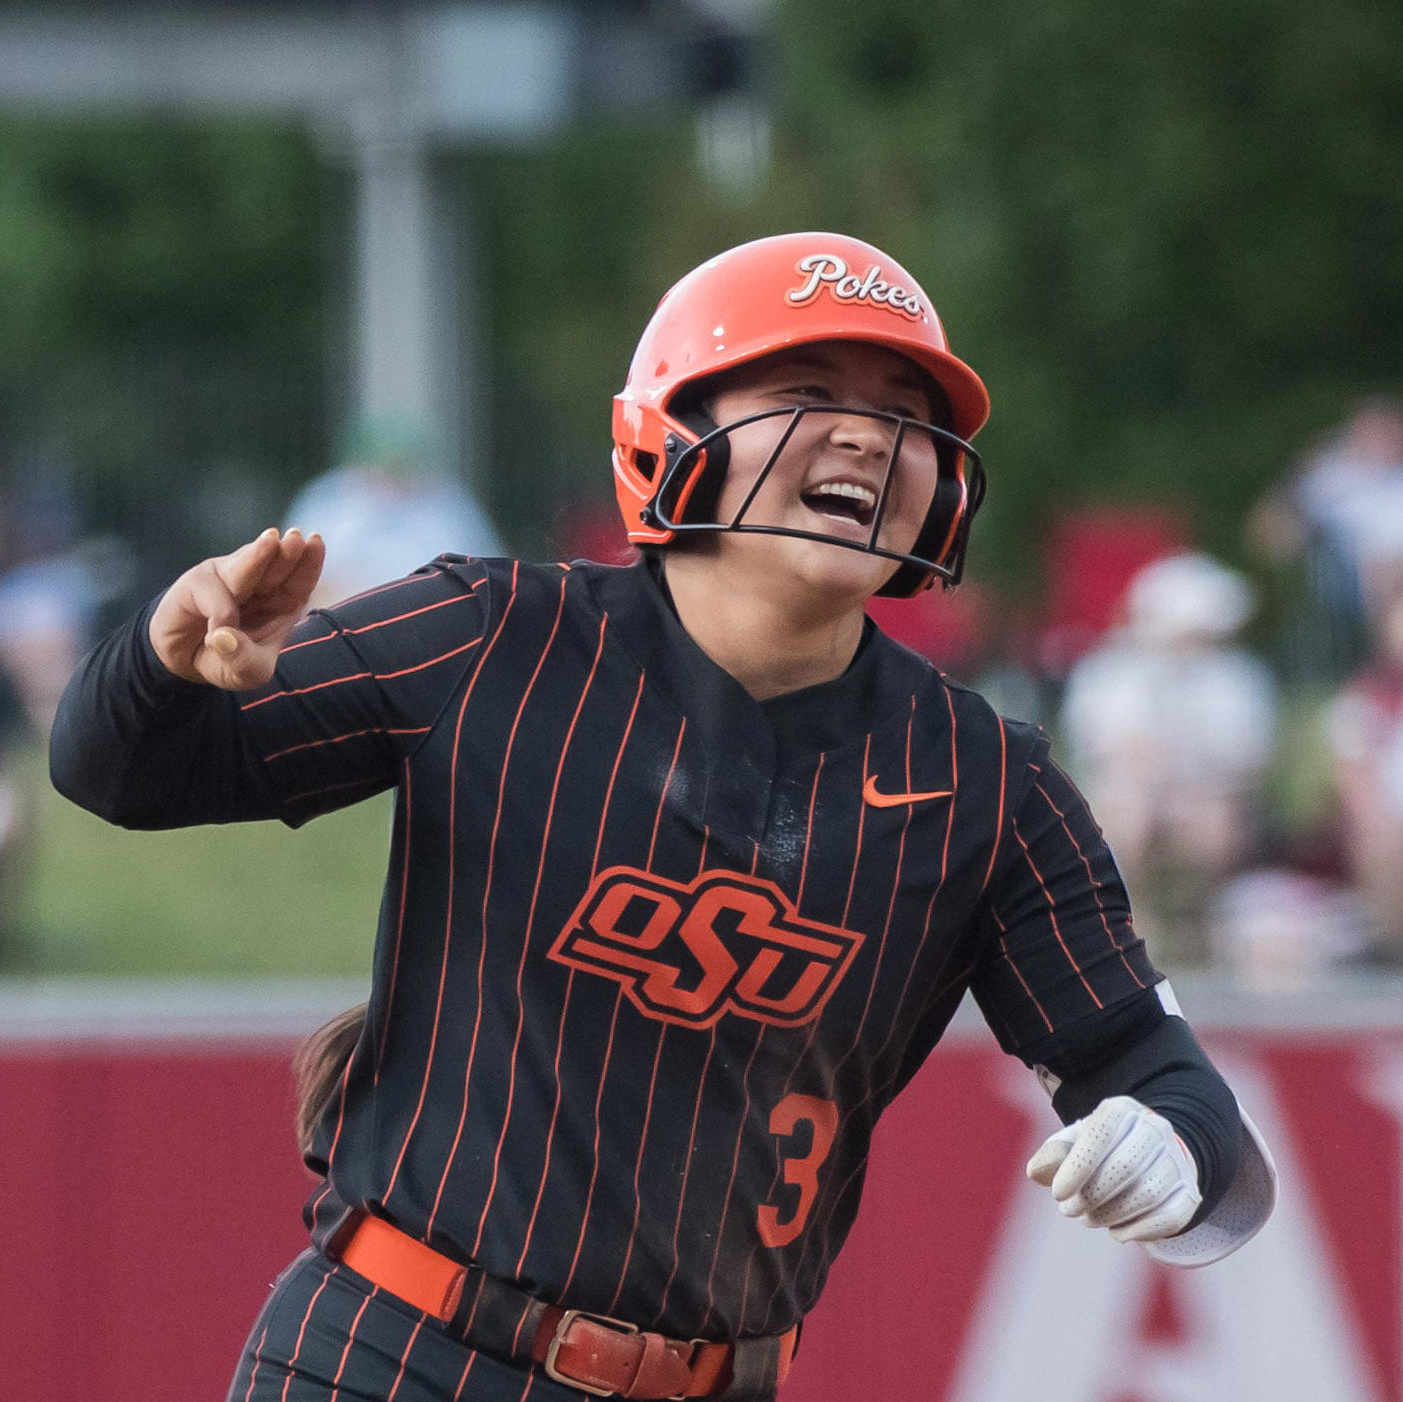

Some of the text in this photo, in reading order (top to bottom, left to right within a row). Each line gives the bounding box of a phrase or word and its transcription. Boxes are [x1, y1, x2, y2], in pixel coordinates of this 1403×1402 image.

[788, 253, 929, 319] Pokes
[547, 865, 865, 1029] OSU
[757, 1093, 838, 1248] 3
